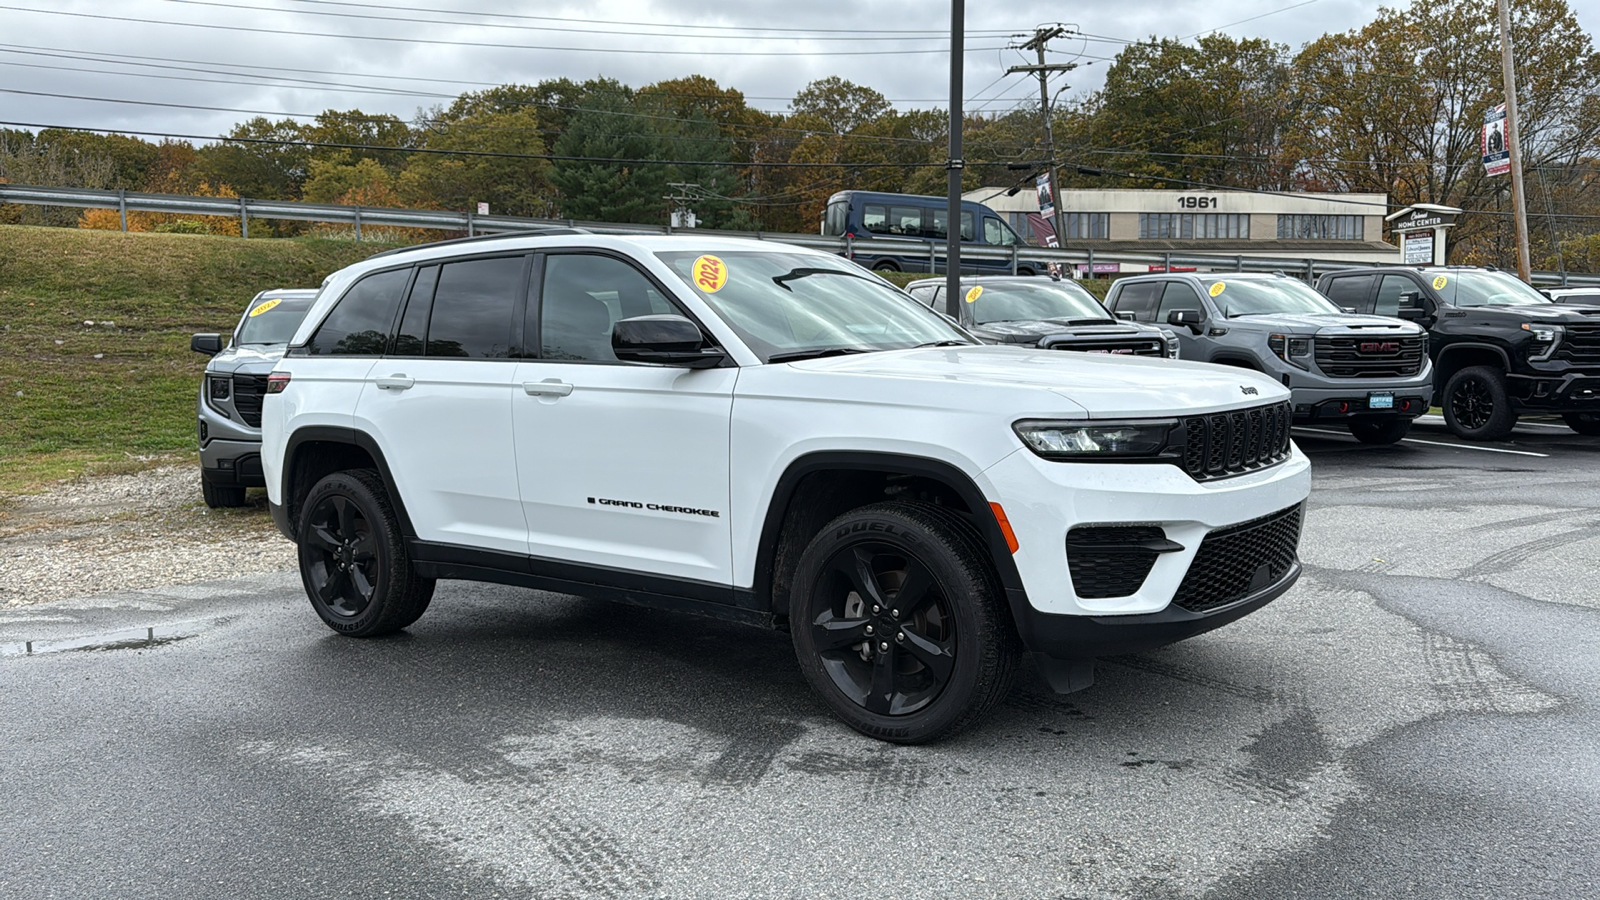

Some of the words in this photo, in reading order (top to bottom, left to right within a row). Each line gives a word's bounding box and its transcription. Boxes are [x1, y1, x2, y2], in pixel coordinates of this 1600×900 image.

[1178, 196, 1217, 209] 1961
[1398, 221, 1416, 229] HOME
[1417, 217, 1441, 226] CENTER
[699, 256, 721, 290] 2024
[1360, 342, 1399, 351] GMC
[598, 498, 643, 509] GRAND
[646, 503, 720, 518] CHEROKEE
